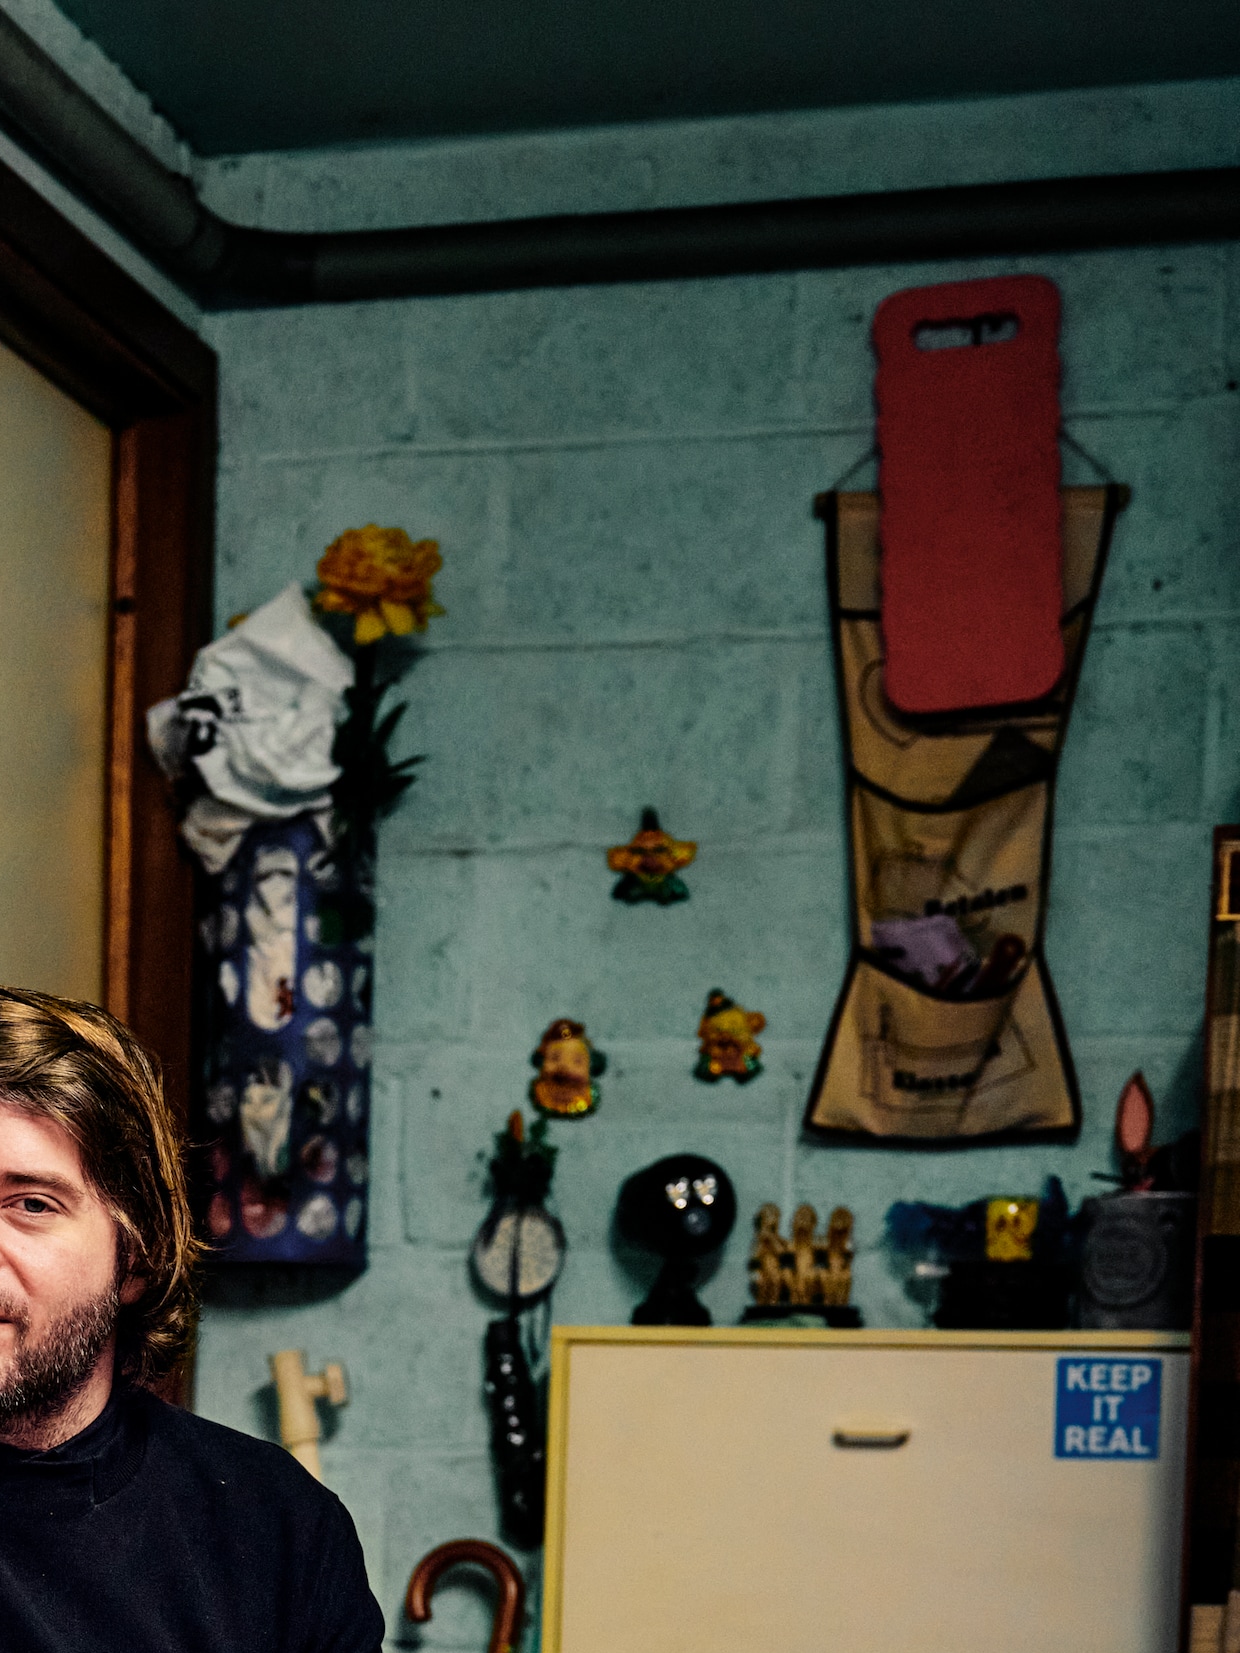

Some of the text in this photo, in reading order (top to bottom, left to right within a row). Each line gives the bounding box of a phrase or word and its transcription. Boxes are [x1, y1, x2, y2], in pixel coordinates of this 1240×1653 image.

[1067, 1364, 1152, 1391] KEEP
[1093, 1394, 1124, 1422] IT
[1065, 1425, 1150, 1455] REAL
